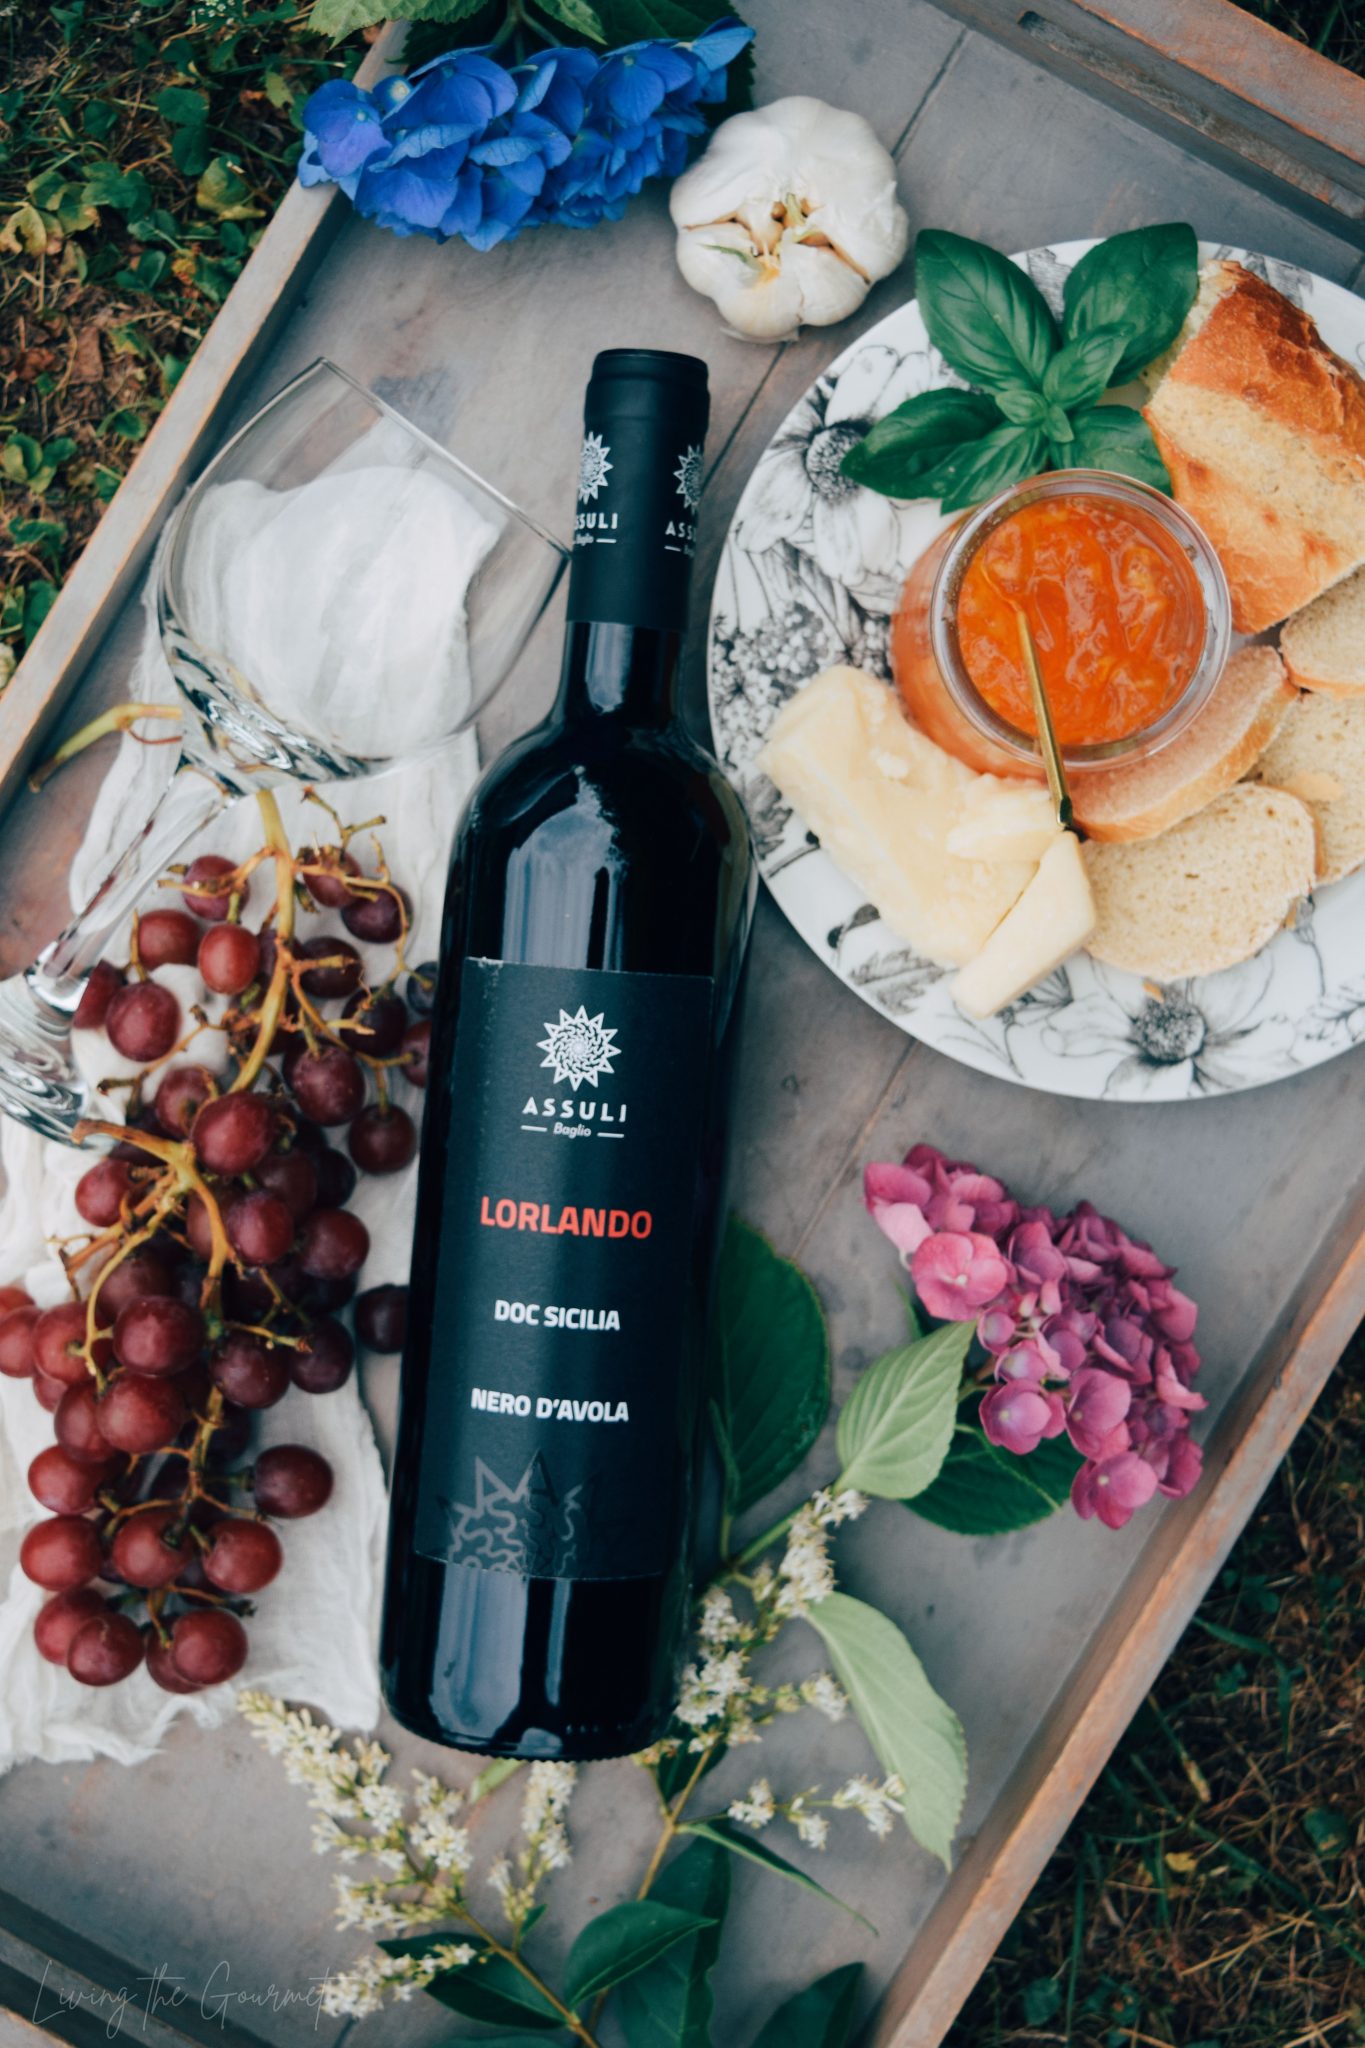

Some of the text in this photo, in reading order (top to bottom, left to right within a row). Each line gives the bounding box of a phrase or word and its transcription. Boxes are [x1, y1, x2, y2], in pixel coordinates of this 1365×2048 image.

[521, 1096, 627, 1123] ASSULI
[553, 1122, 592, 1139] Baglio
[480, 1196, 653, 1240] LORLANDO
[494, 1299, 621, 1332] DOC SICILIA
[470, 1387, 629, 1423] NERO D'AVOLA
